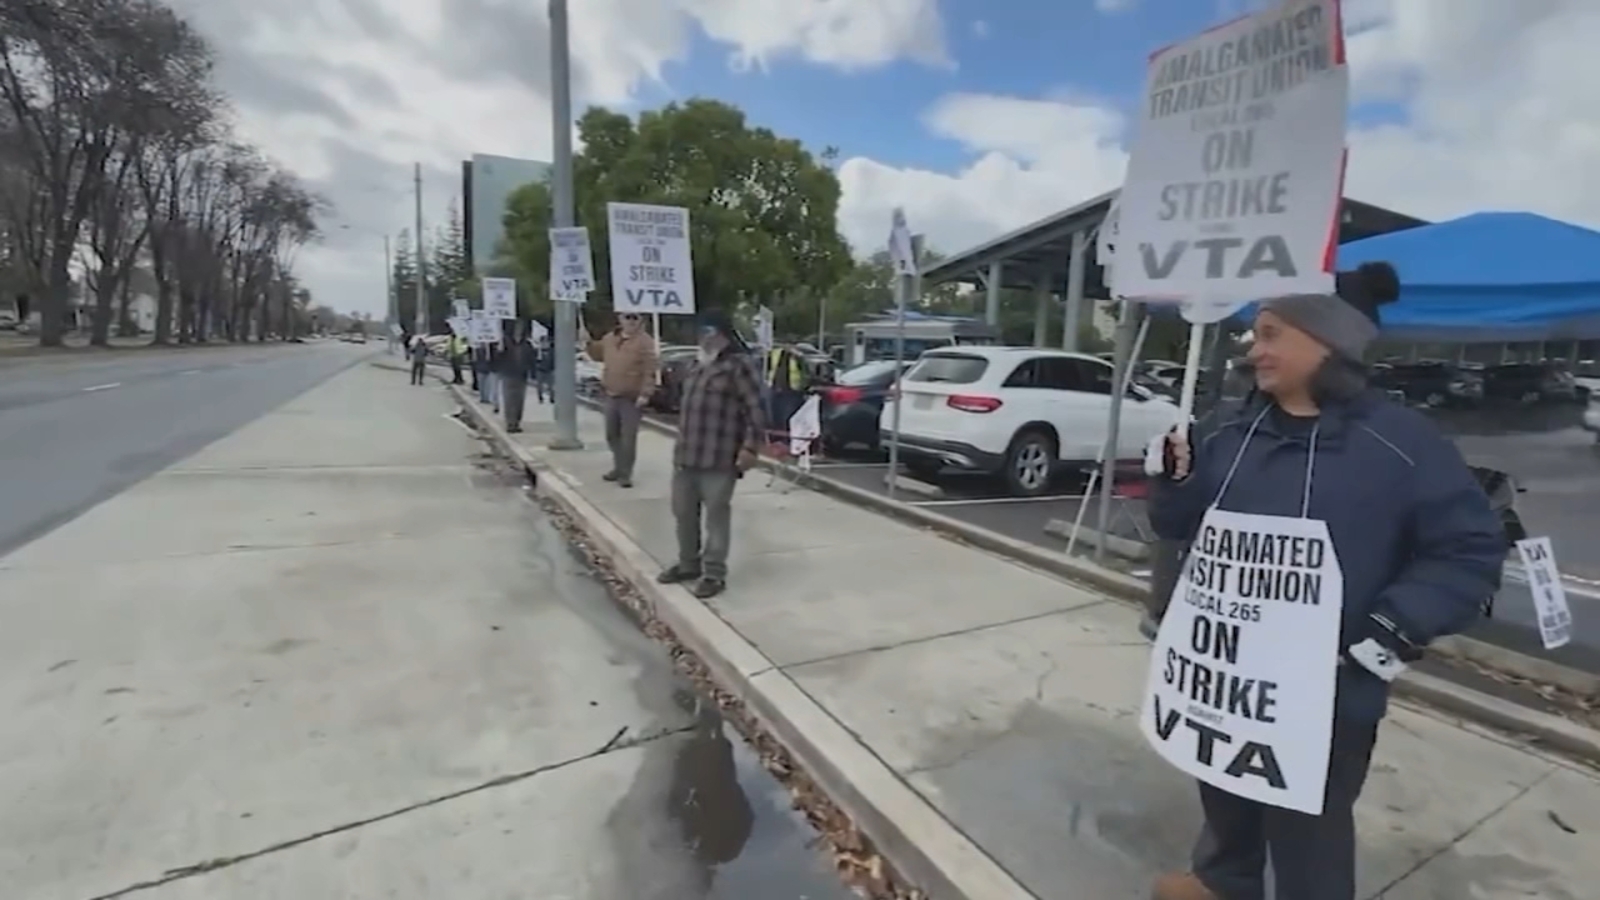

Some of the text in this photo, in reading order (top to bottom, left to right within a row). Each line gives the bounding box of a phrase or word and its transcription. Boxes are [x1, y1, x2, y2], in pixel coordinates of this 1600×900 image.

[1202, 130, 1254, 174] ON
[1158, 171, 1290, 221] STRIKE
[629, 264, 677, 284] STRIKE
[642, 246, 661, 263] ON
[1139, 235, 1298, 280] VTA
[625, 288, 683, 308] VTA
[1196, 525, 1325, 569] GAMATED
[1185, 587, 1261, 623] LOCAL 265
[1238, 563, 1321, 606] UNION
[1191, 615, 1241, 665] ON
[1164, 647, 1278, 724] STRIKE
[1154, 694, 1288, 790] VTA
